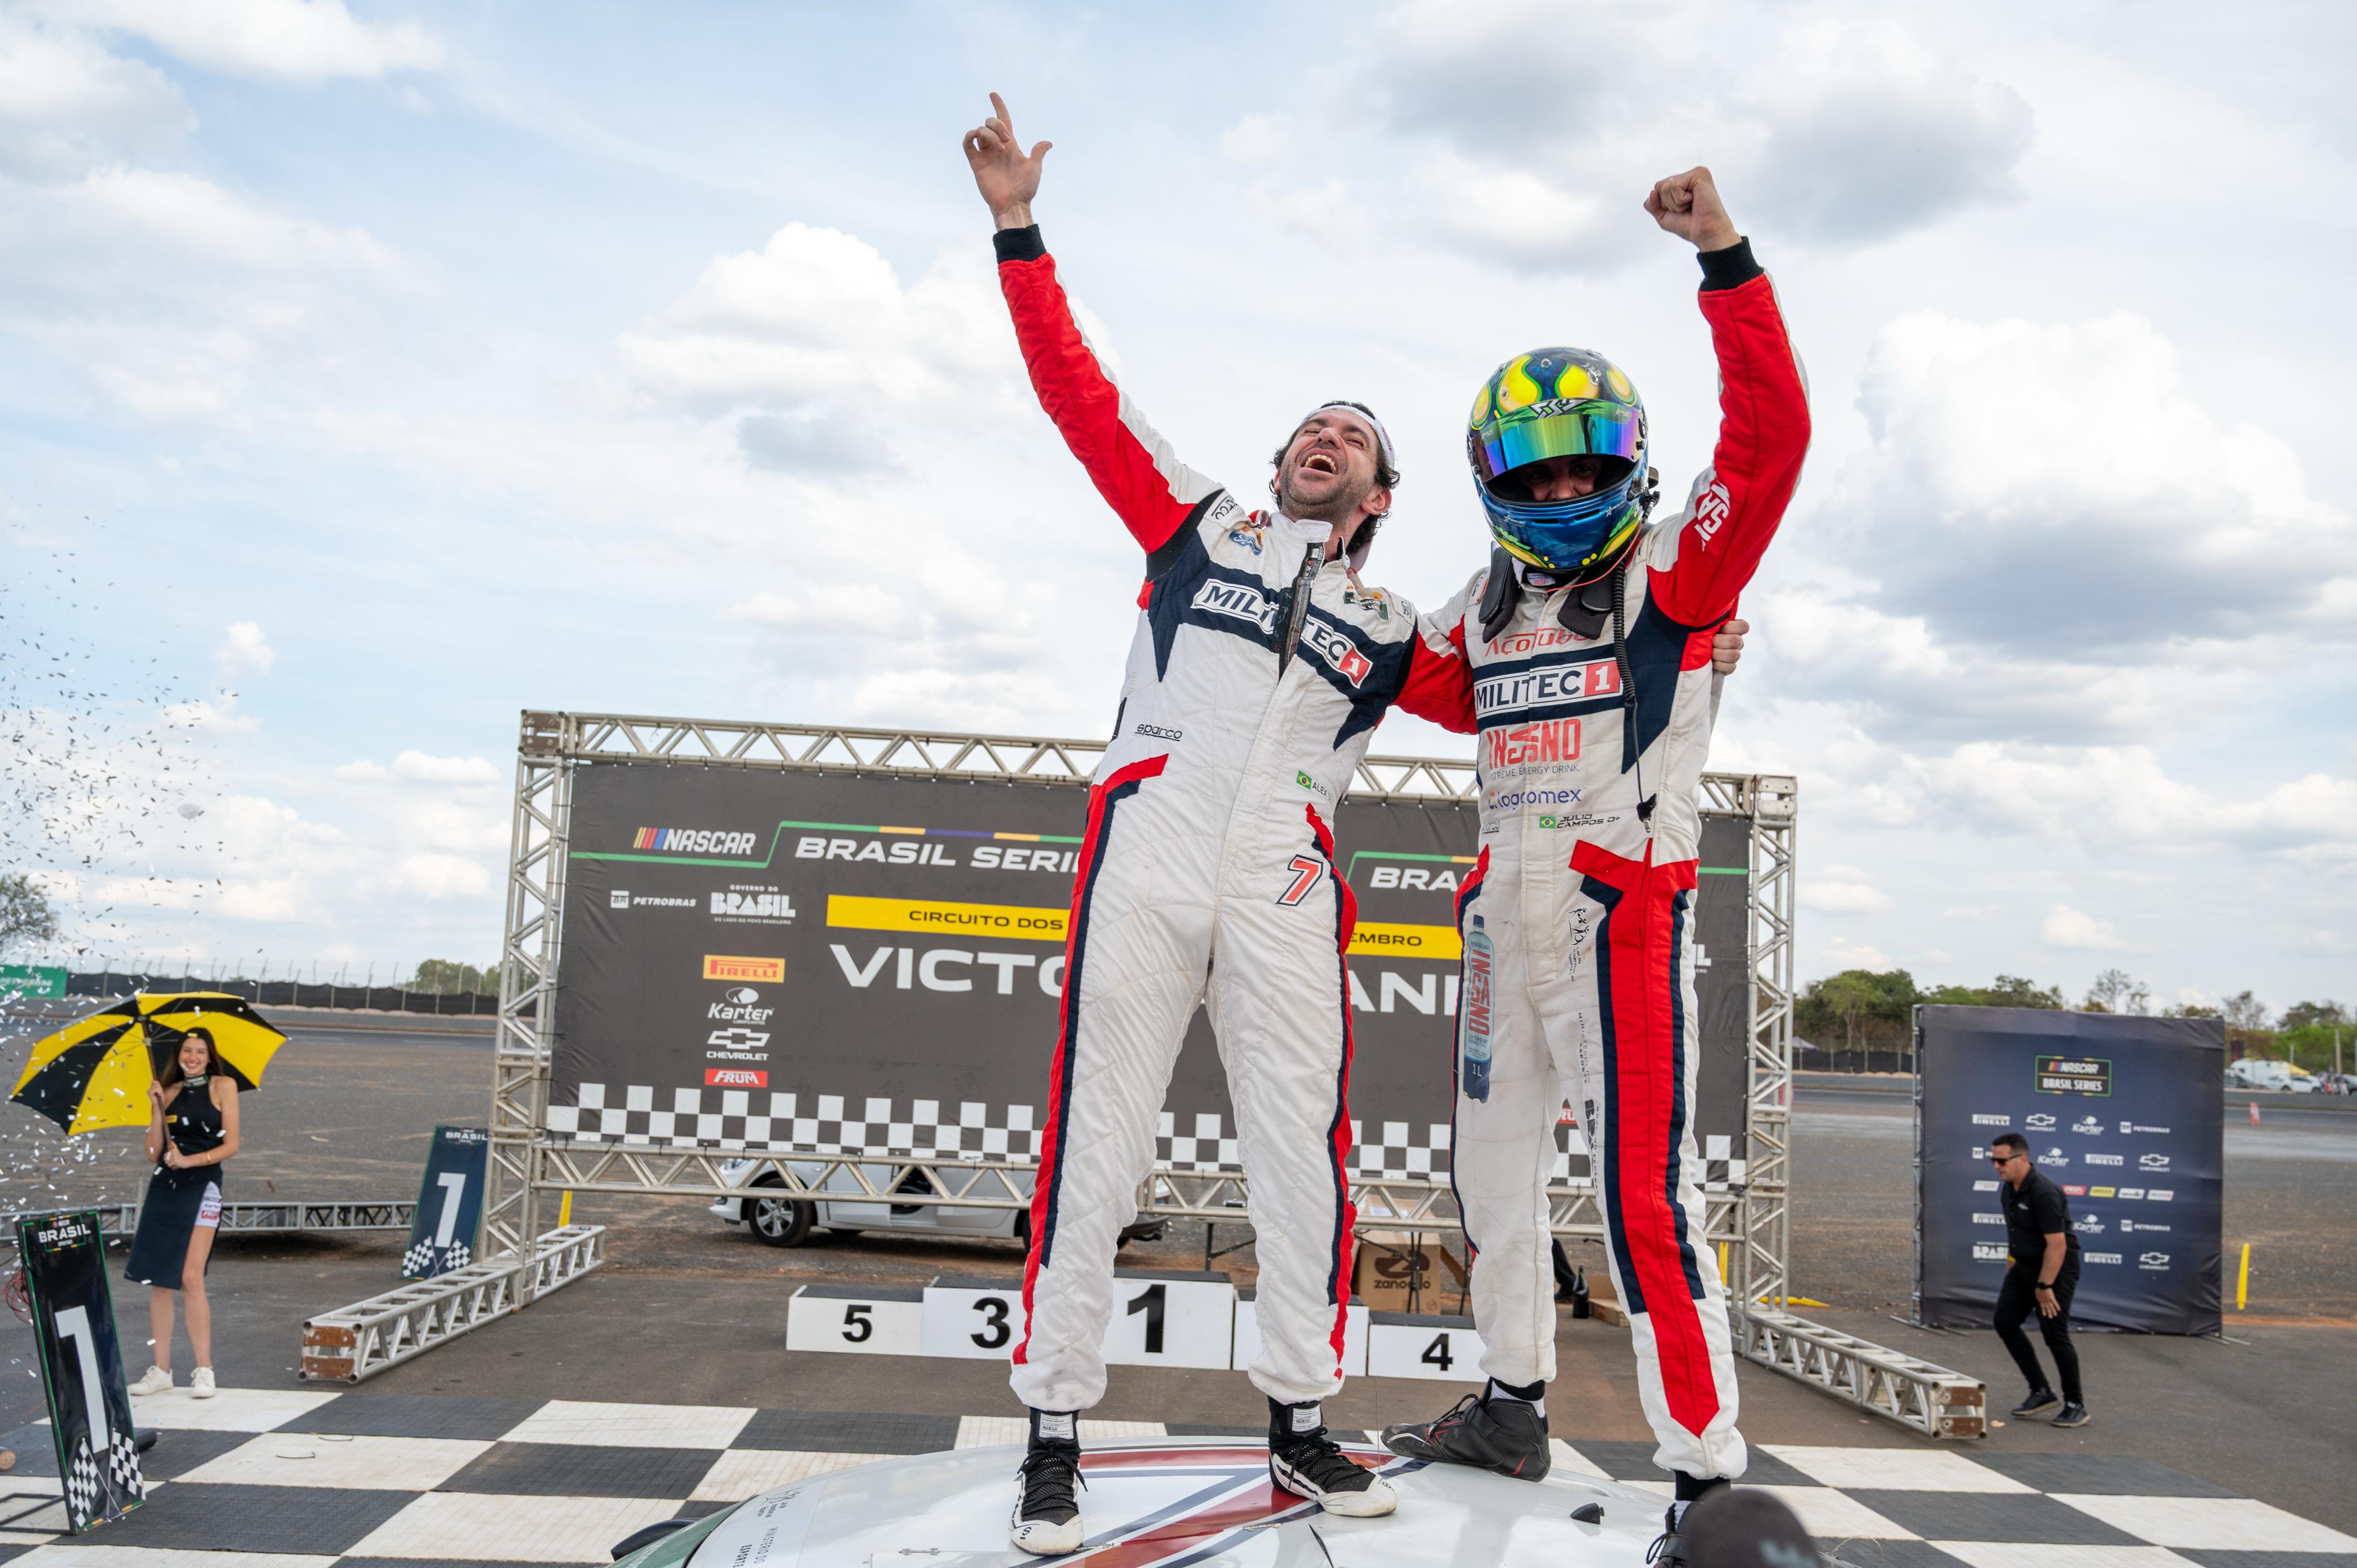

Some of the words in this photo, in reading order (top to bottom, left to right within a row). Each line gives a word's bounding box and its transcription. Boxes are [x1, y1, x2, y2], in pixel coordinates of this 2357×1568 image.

[1347, 657, 1361, 677] 1
[1475, 670, 1582, 711] MILITEC
[1595, 665, 1611, 691] 1
[1135, 723, 1183, 742] sparco
[1519, 766, 1549, 776] ENERGY
[1552, 764, 1580, 774] DRINK
[1556, 819, 1605, 829] CAMPOS
[662, 828, 756, 855] NASCAR
[795, 837, 956, 866] BRASIL
[1275, 854, 1324, 907] 7
[1369, 867, 1467, 892] BRA
[633, 896, 697, 907] PETROBRAS
[710, 892, 796, 918] BRASIL
[909, 910, 1010, 927] CIRCUITO
[1017, 918, 1063, 930] DOS
[710, 960, 779, 978] PIRELLI
[708, 1003, 773, 1021] Karter
[707, 1051, 769, 1061] CHEVROLET
[713, 1071, 760, 1084] FRUM
[2060, 1062, 2099, 1075] NASCAR
[2042, 1077, 2072, 1089] BRASIL
[2073, 1079, 2103, 1092] SERIES
[445, 1131, 488, 1141] BRASIL
[435, 1172, 466, 1248] 1
[1972, 1213, 2007, 1225] PIRELL
[38, 1224, 91, 1243] BRASIL
[842, 1304, 872, 1343] 5
[971, 1297, 1011, 1349] 3
[1128, 1284, 1167, 1354] 1
[1422, 1333, 1453, 1371] 4
[54, 1305, 109, 1454] 1
